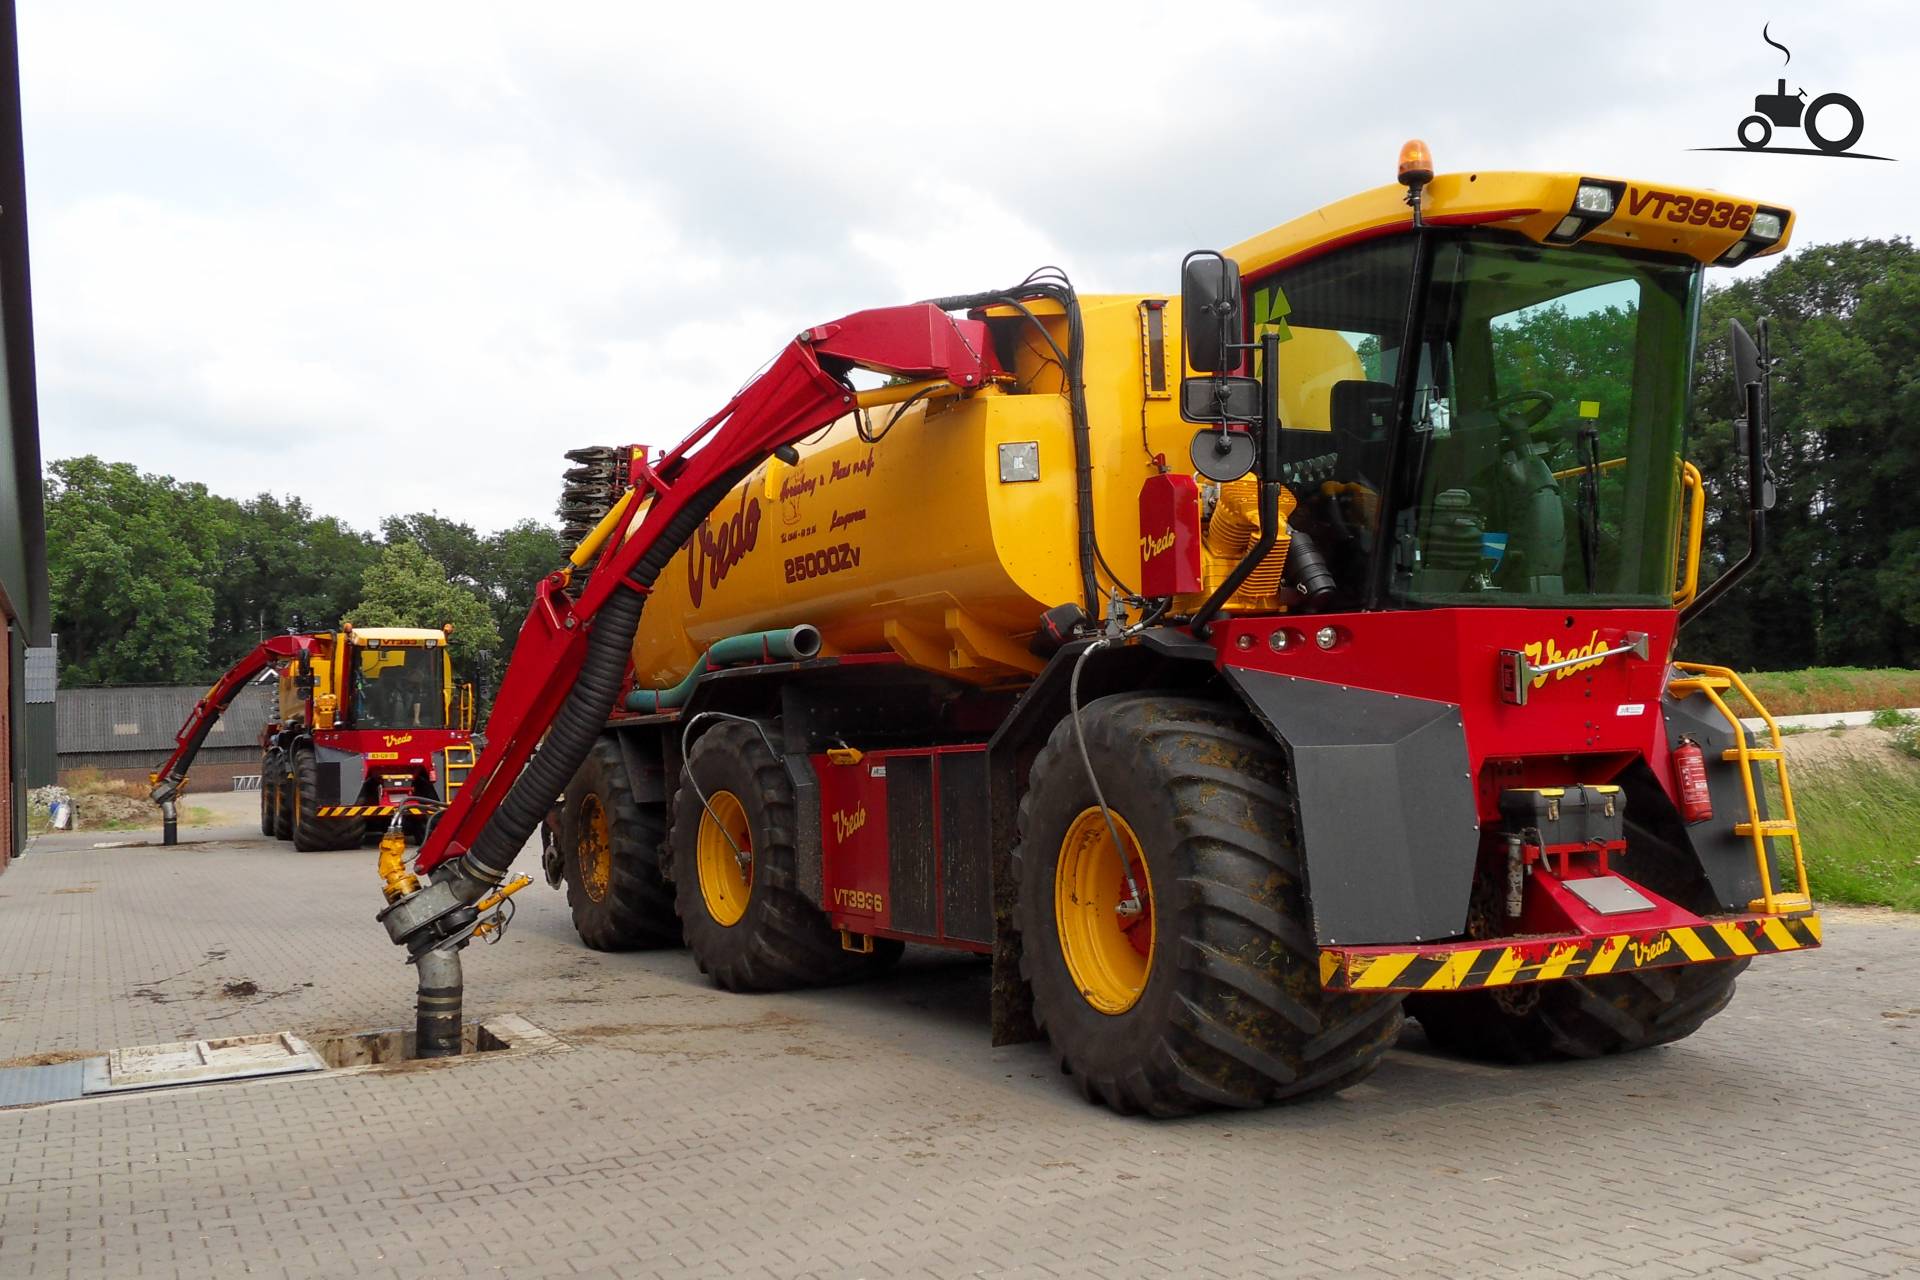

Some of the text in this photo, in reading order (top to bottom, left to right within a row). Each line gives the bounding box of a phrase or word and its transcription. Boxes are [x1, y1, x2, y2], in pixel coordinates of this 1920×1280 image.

[1630, 187, 1754, 231] VT3936
[680, 478, 761, 609] Vredo
[1140, 526, 1176, 562] Vredo
[1525, 629, 1609, 688] Vredo
[382, 732, 413, 748] Vredo
[832, 800, 866, 844] Vredo
[833, 887, 883, 913] VT3936
[1628, 932, 1672, 967] Vredo
